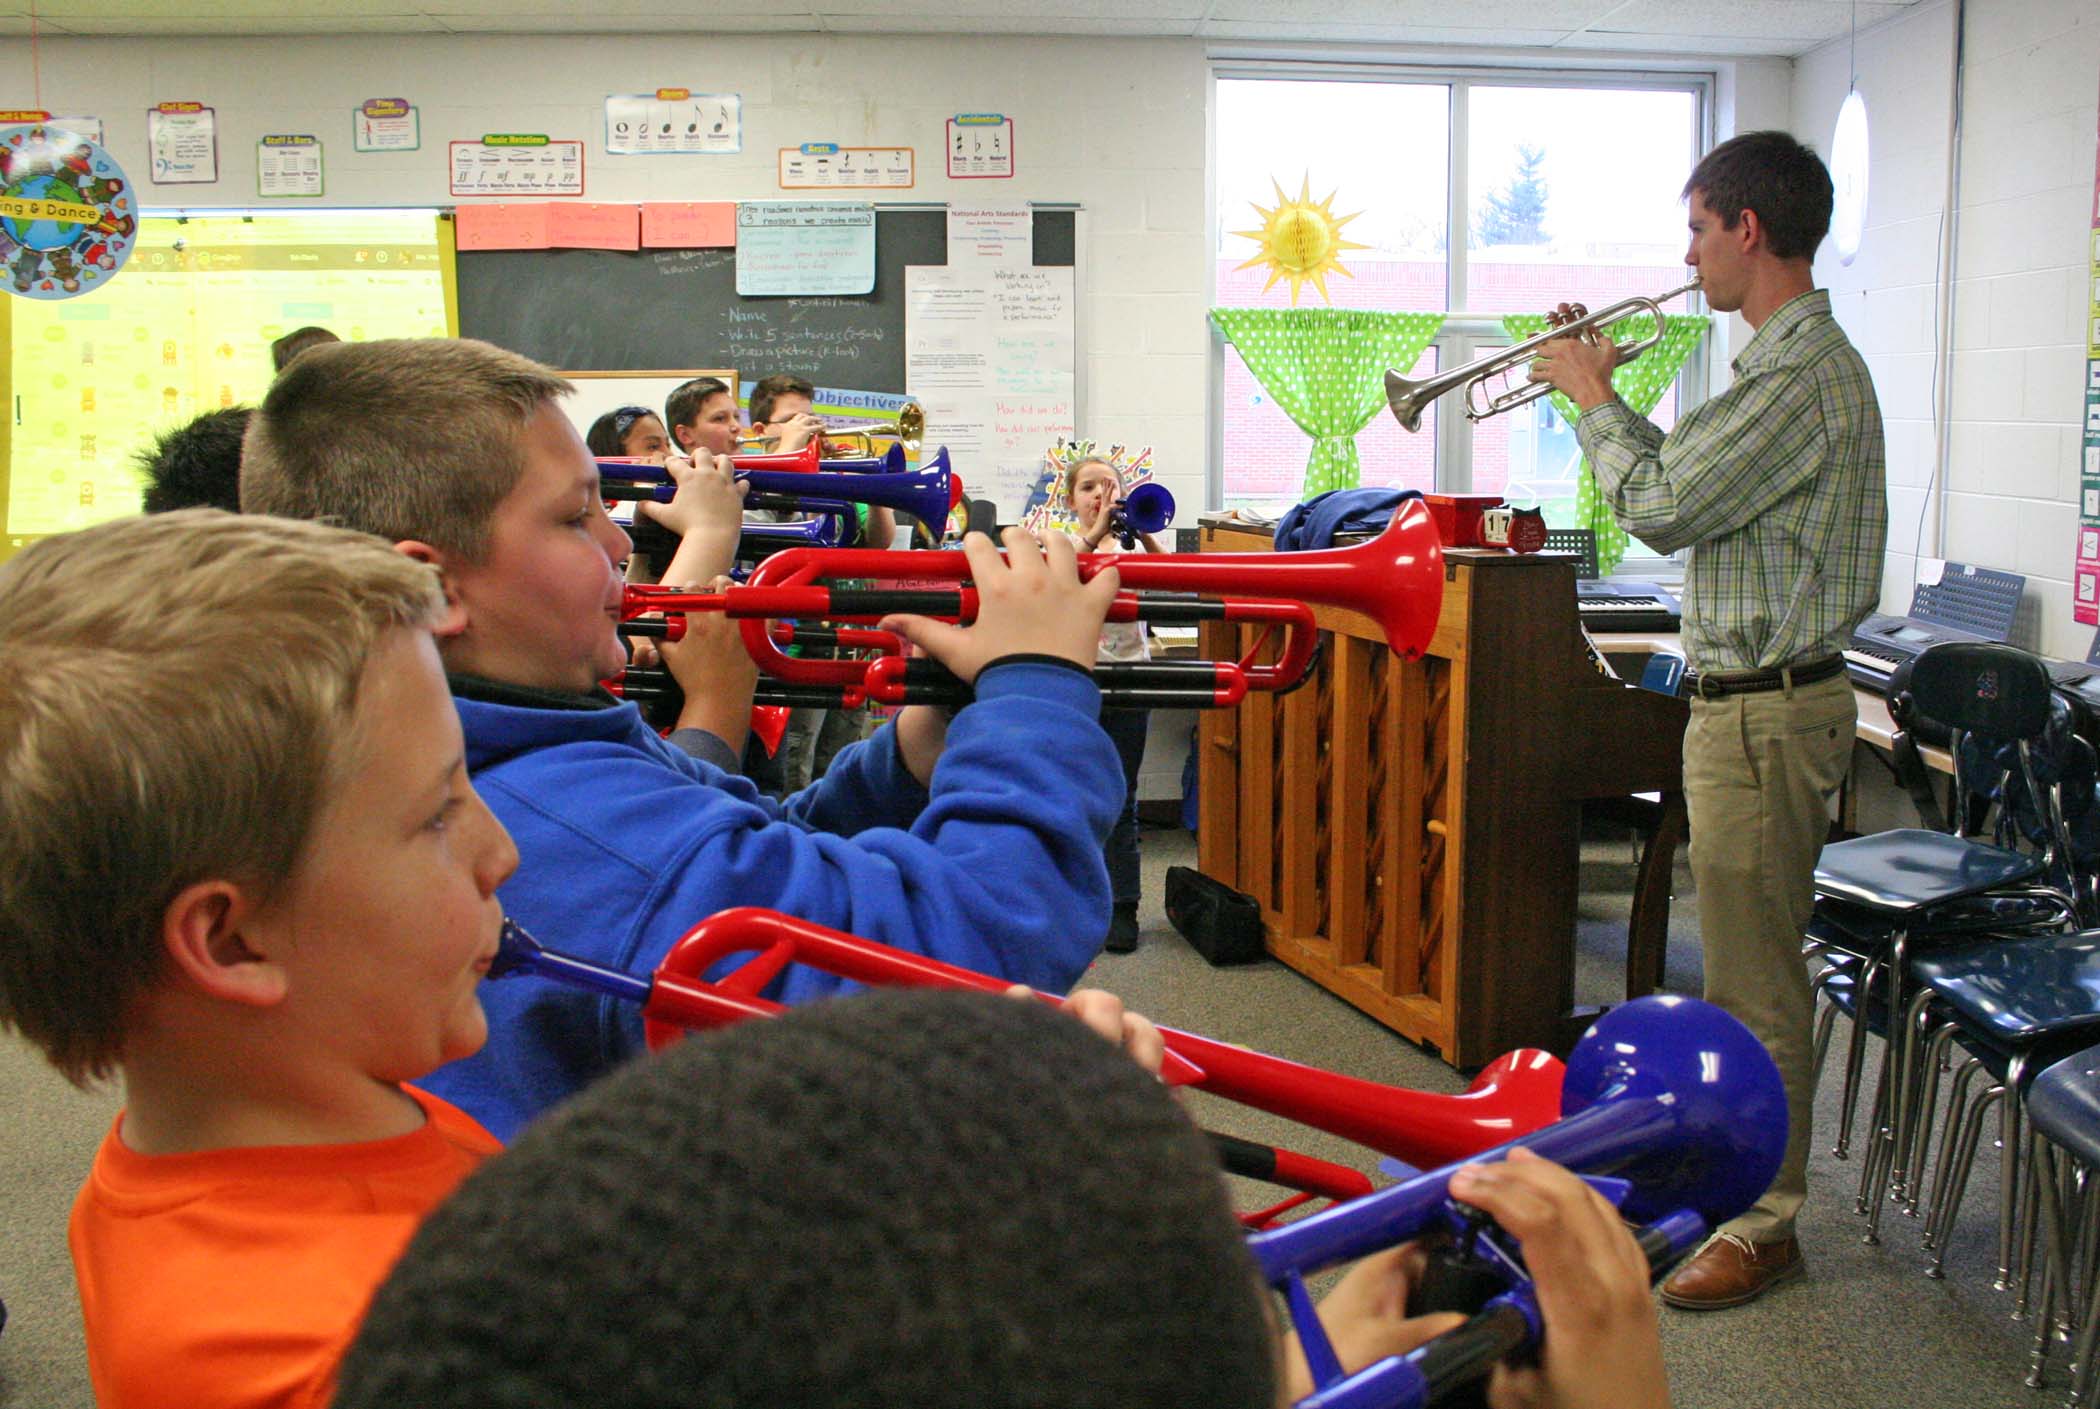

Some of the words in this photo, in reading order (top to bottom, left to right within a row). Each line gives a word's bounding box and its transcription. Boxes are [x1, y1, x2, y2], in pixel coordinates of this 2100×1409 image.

[30, 202, 40, 214] &
[47, 203, 97, 219] Dance
[951, 209, 980, 217] National
[981, 209, 995, 217] Arts
[996, 209, 1029, 217] Standards
[728, 305, 768, 324] Name
[764, 327, 778, 342] 5
[813, 388, 906, 411] Objectives
